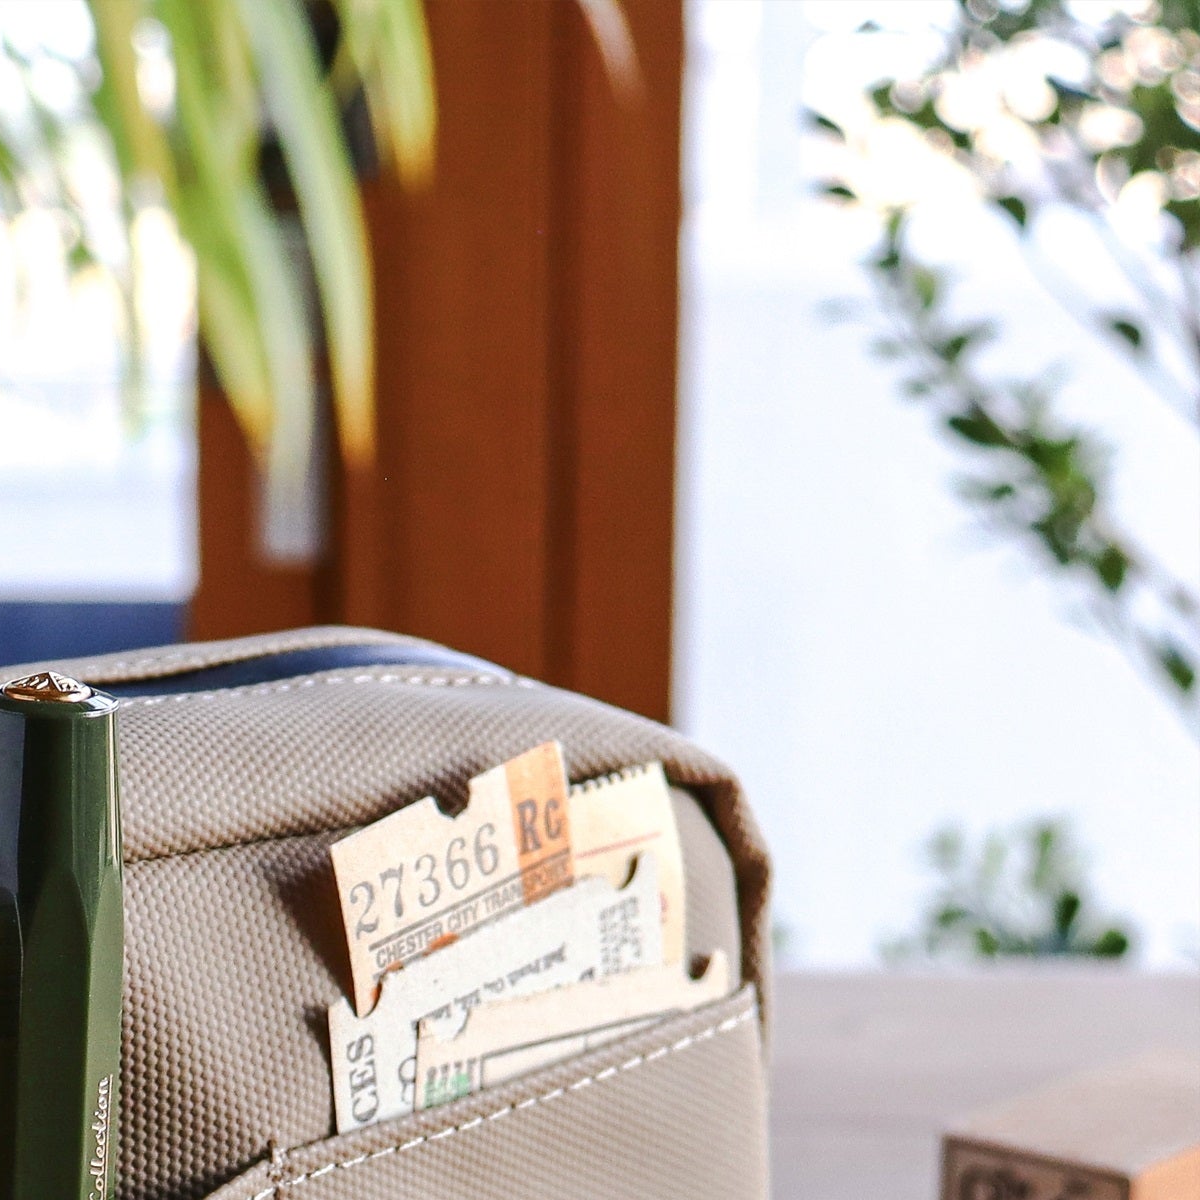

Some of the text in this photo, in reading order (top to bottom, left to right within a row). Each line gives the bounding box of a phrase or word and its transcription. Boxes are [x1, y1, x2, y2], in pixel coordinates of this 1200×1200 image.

[349, 822, 499, 939] 27366
[376, 922, 443, 968] CHESTER
[448, 905, 479, 930] CITY
